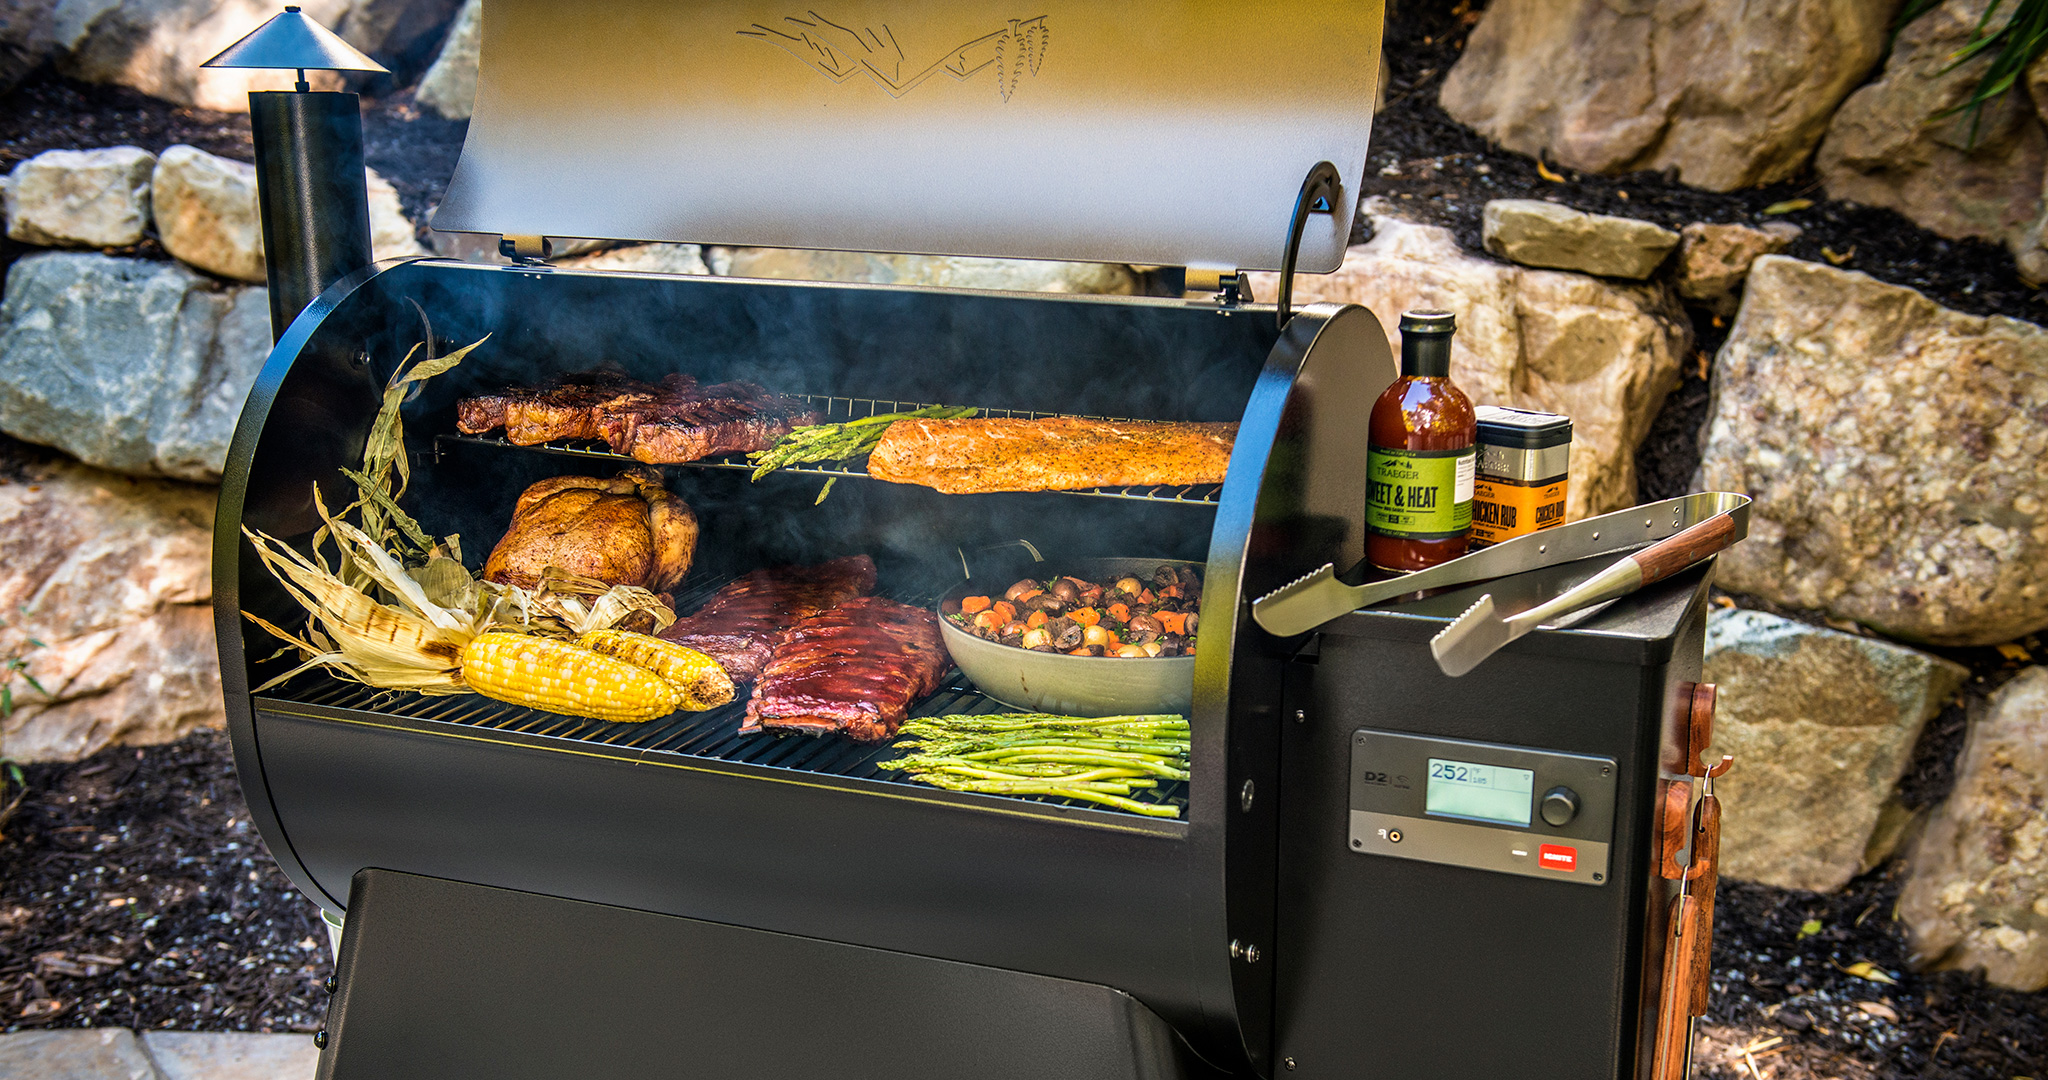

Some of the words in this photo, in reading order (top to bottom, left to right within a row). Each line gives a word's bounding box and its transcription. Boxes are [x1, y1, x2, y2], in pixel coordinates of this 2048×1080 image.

[1377, 466, 1419, 479] TRAEGER
[1475, 460, 1510, 473] AEGER
[1394, 484, 1405, 508] &
[1408, 486, 1438, 508] HEAT
[1475, 490, 1496, 499] AEGER
[1472, 499, 1499, 525] HICKEN
[1501, 504, 1517, 528] RUB
[1364, 771, 1387, 782] D2
[1431, 762, 1468, 782] 252
